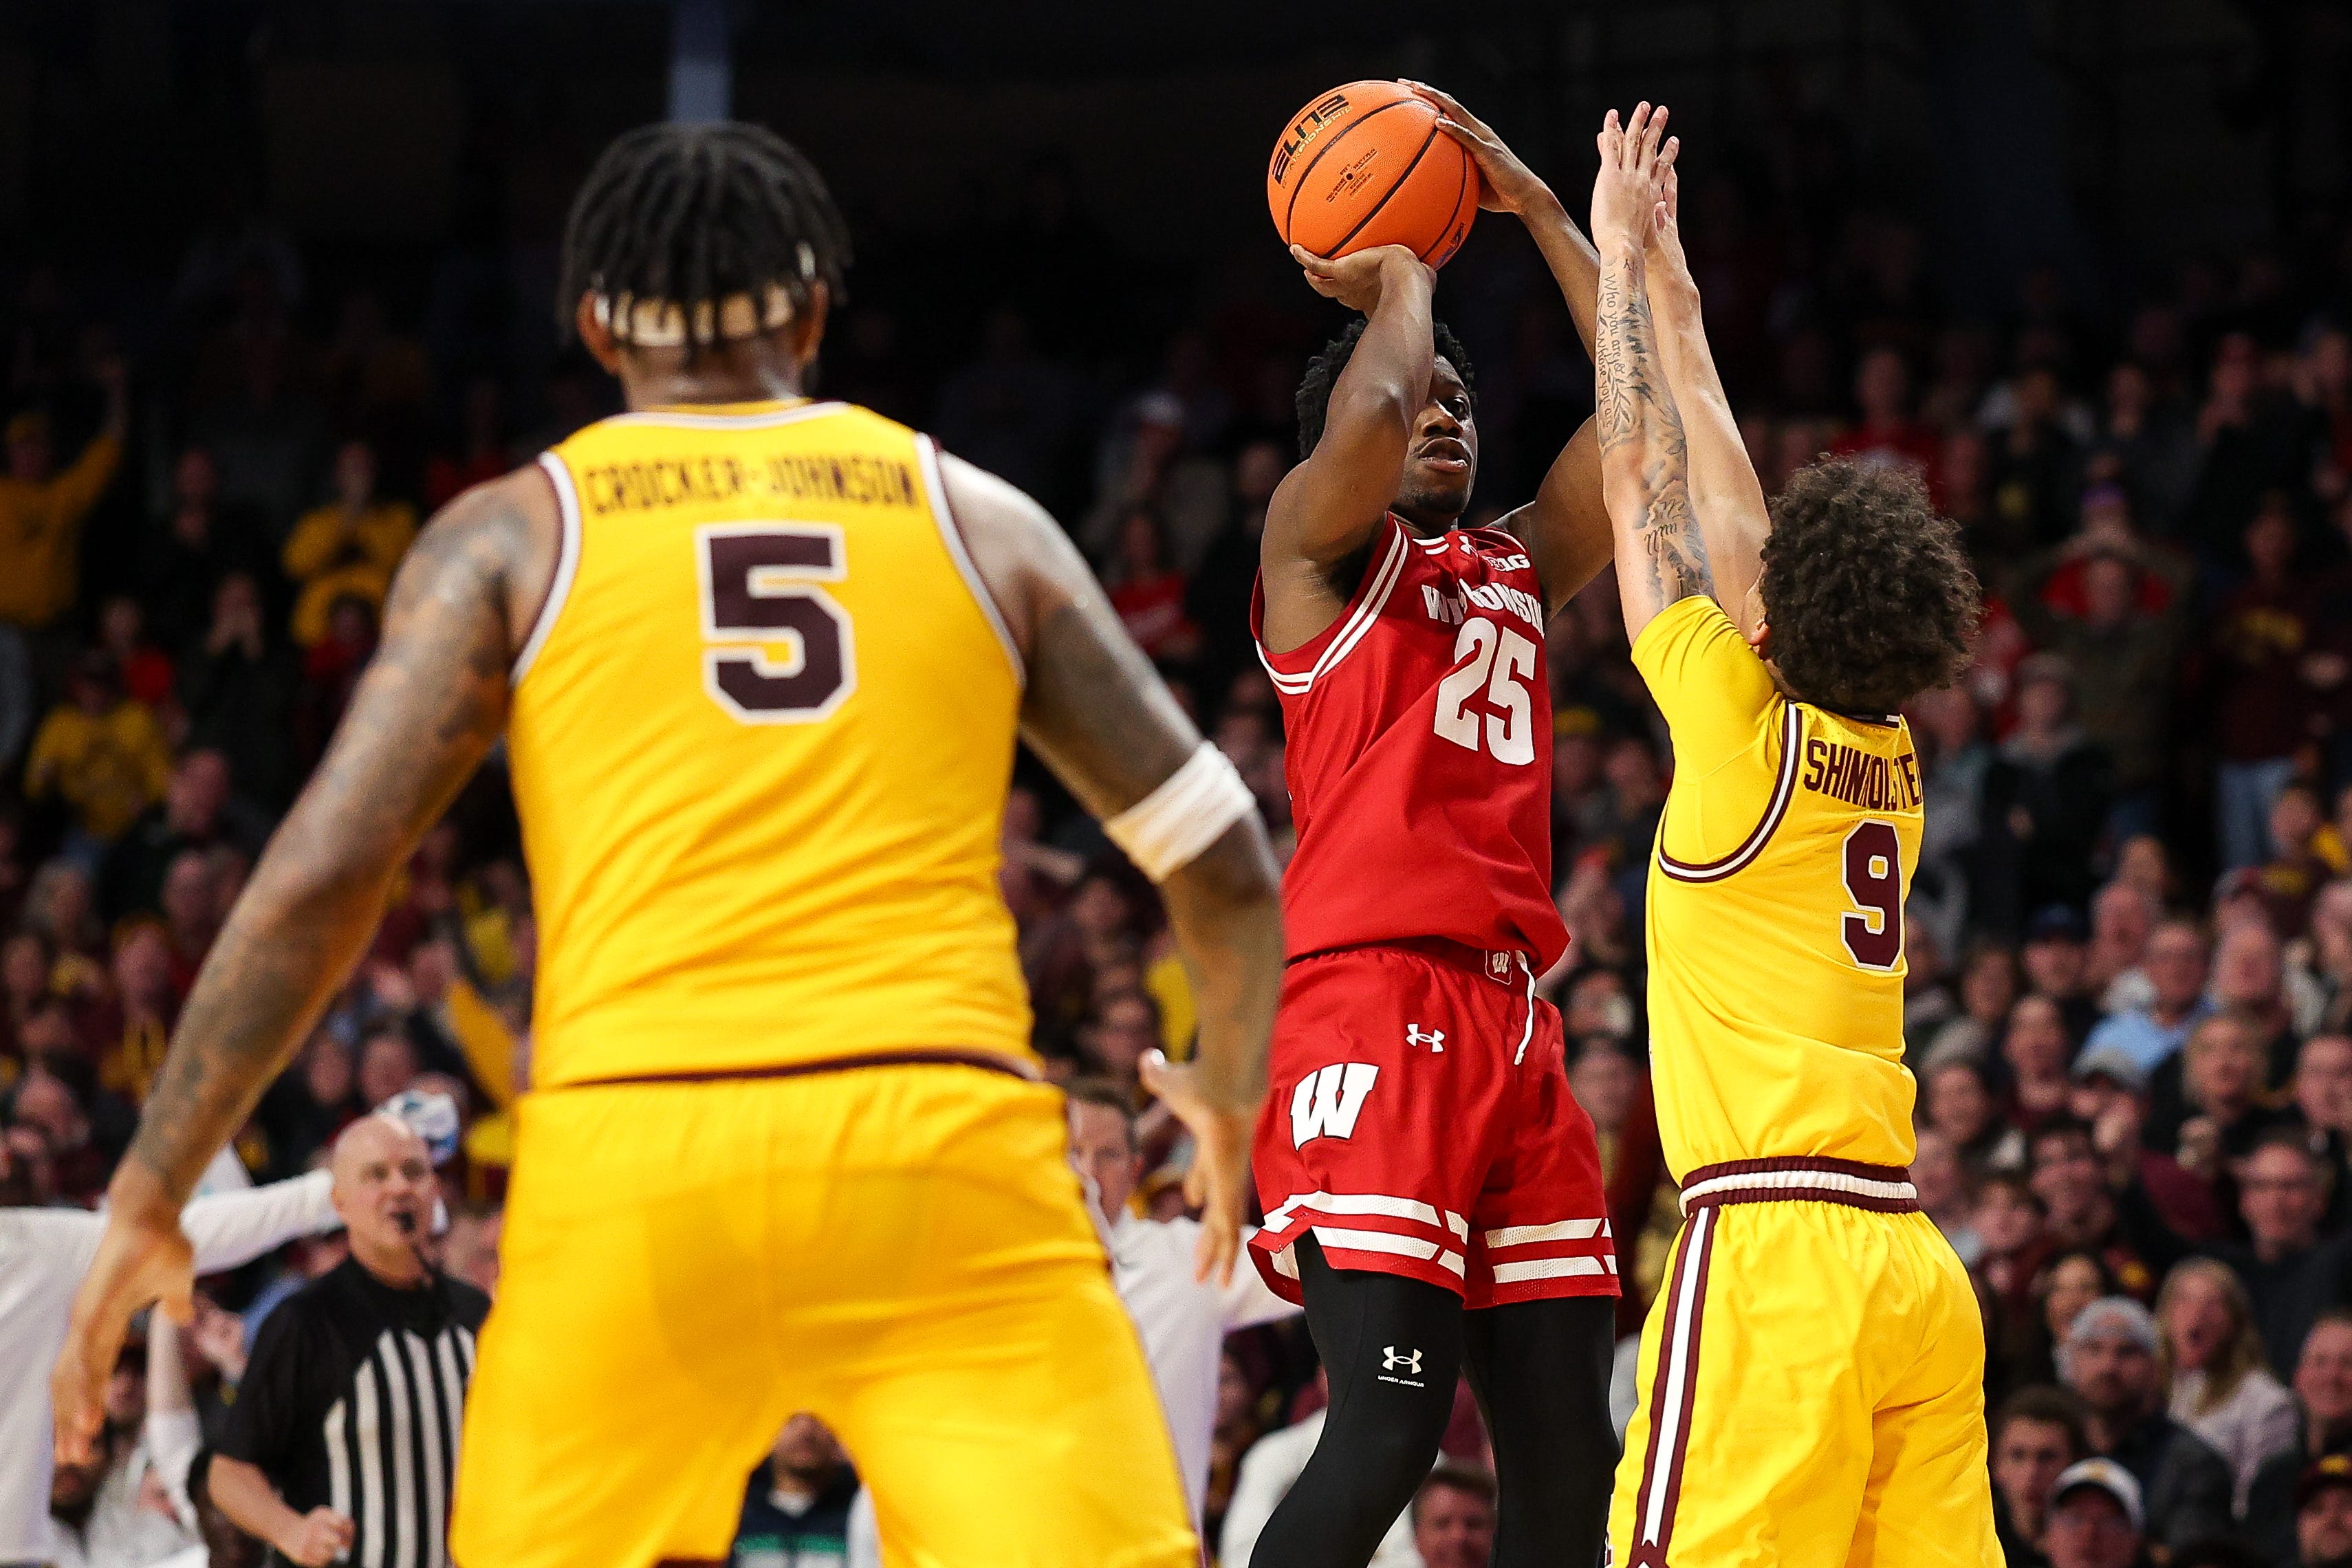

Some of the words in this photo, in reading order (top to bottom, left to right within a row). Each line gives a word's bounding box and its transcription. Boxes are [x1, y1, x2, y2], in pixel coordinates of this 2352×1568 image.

[1272, 94, 1349, 185] ELITE
[1604, 274, 1620, 308] Who
[1604, 310, 1620, 336] you
[696, 521, 857, 726] 5
[1433, 617, 1536, 765] 25
[1840, 818, 1904, 972] 9
[1492, 952, 1510, 974] W
[1289, 1062, 1380, 1153] W
[1378, 1375, 1399, 1383] UNDER
[1399, 1380, 1424, 1388] ARMOUR
